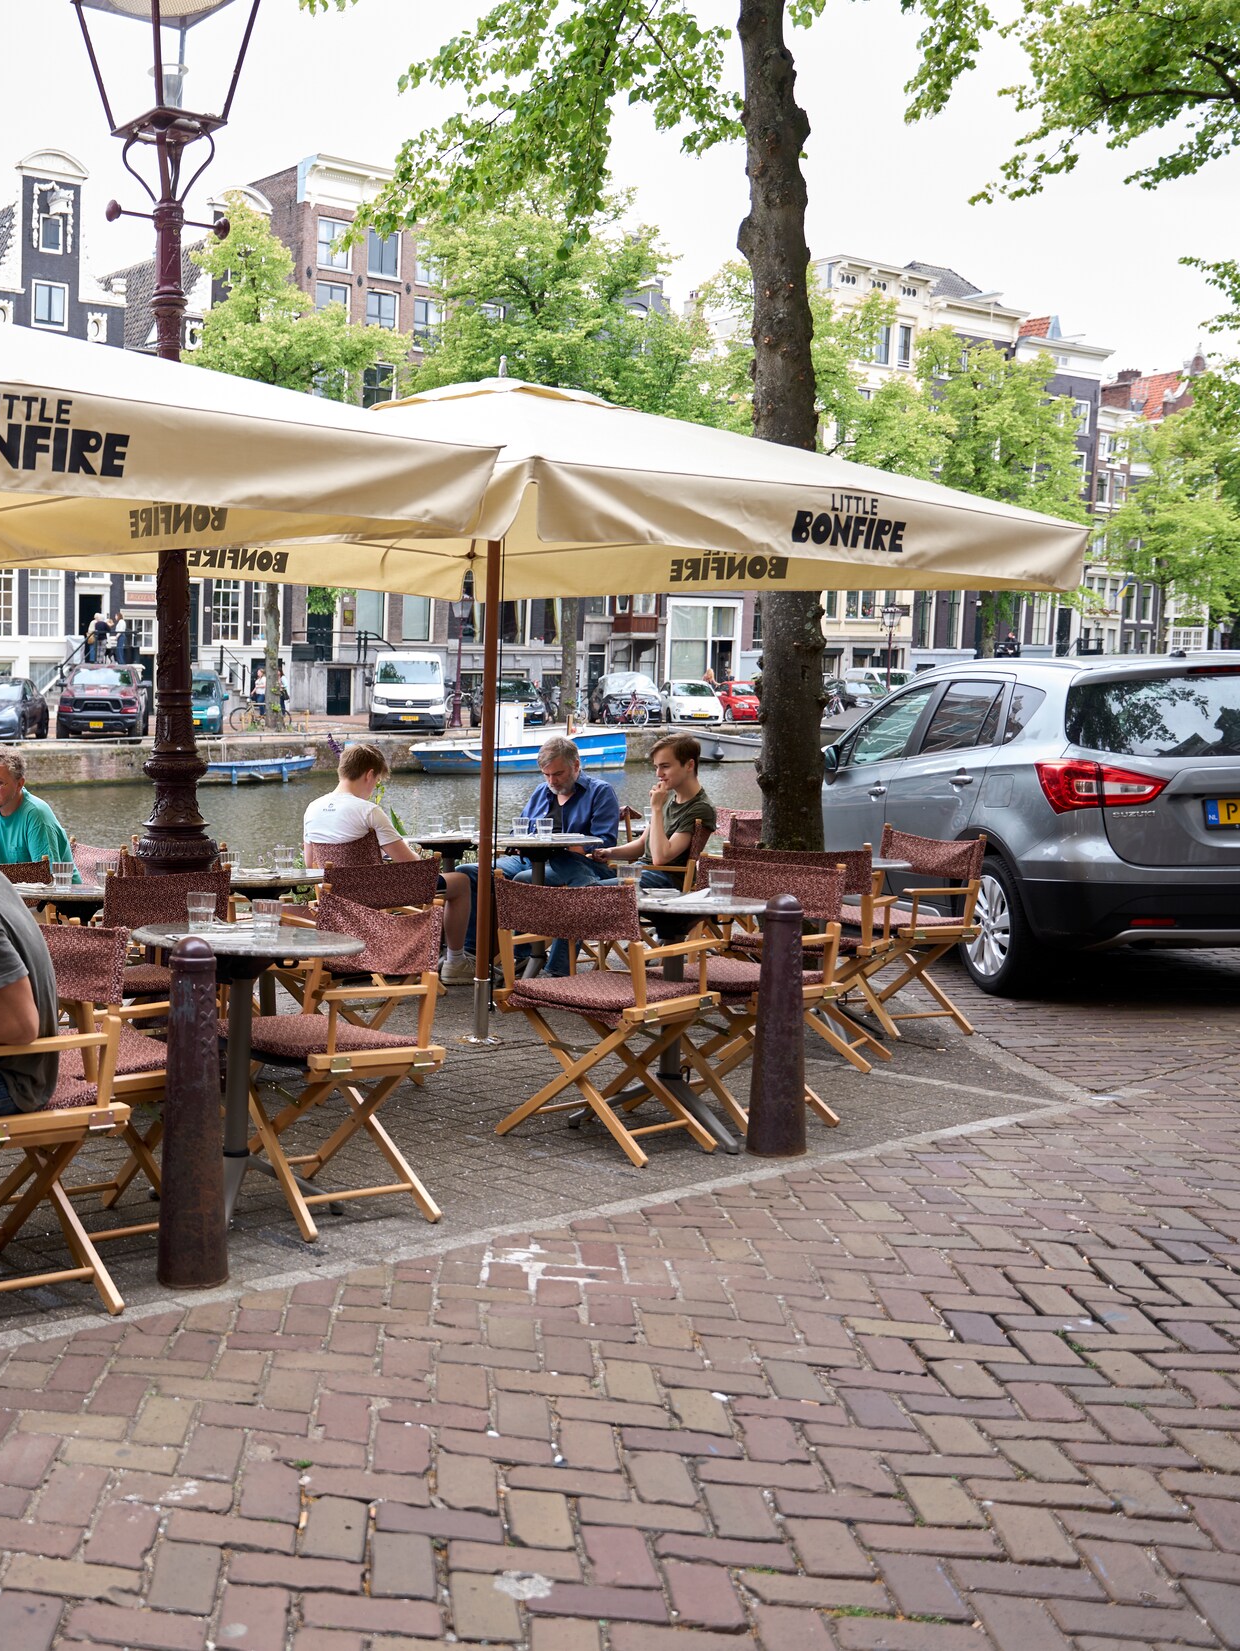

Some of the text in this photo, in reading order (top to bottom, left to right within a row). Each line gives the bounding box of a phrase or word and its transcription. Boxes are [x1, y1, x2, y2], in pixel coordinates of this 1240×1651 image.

[831, 493, 879, 516] LITTLE
[791, 510, 907, 553] BONFIRE
[1112, 810, 1156, 818] SUZUKI
[1226, 802, 1238, 820] P
